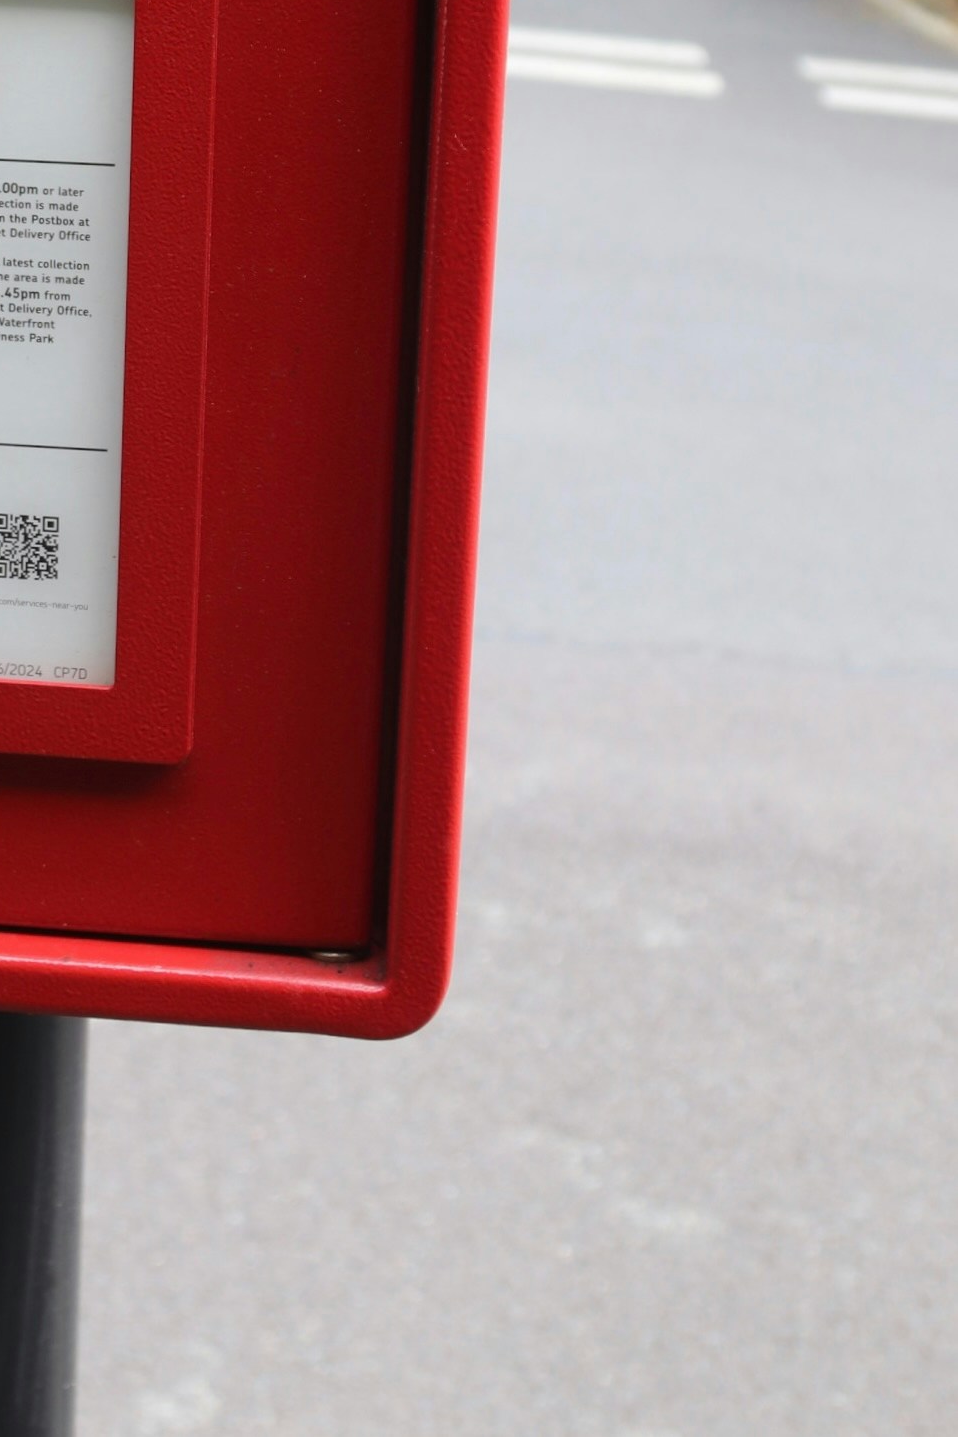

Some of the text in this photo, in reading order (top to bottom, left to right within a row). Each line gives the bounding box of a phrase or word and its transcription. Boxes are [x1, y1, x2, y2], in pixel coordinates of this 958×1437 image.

[42, 187, 55, 196] or
[57, 187, 85, 197] later
[35, 200, 44, 210] is
[48, 201, 79, 212] made
[9, 214, 27, 224] the
[31, 215, 75, 226] Postbox
[78, 217, 90, 227] at
[9, 228, 55, 242] Delivery
[58, 230, 91, 242] Office
[2, 257, 34, 268] latest
[37, 259, 90, 271] collection
[13, 273, 38, 283] area
[41, 273, 51, 284] is
[54, 274, 85, 285] made
[44, 290, 71, 302] from
[8, 303, 54, 316] Delivery
[29, 333, 55, 344] Park
[53, 666, 88, 680] CP7D
